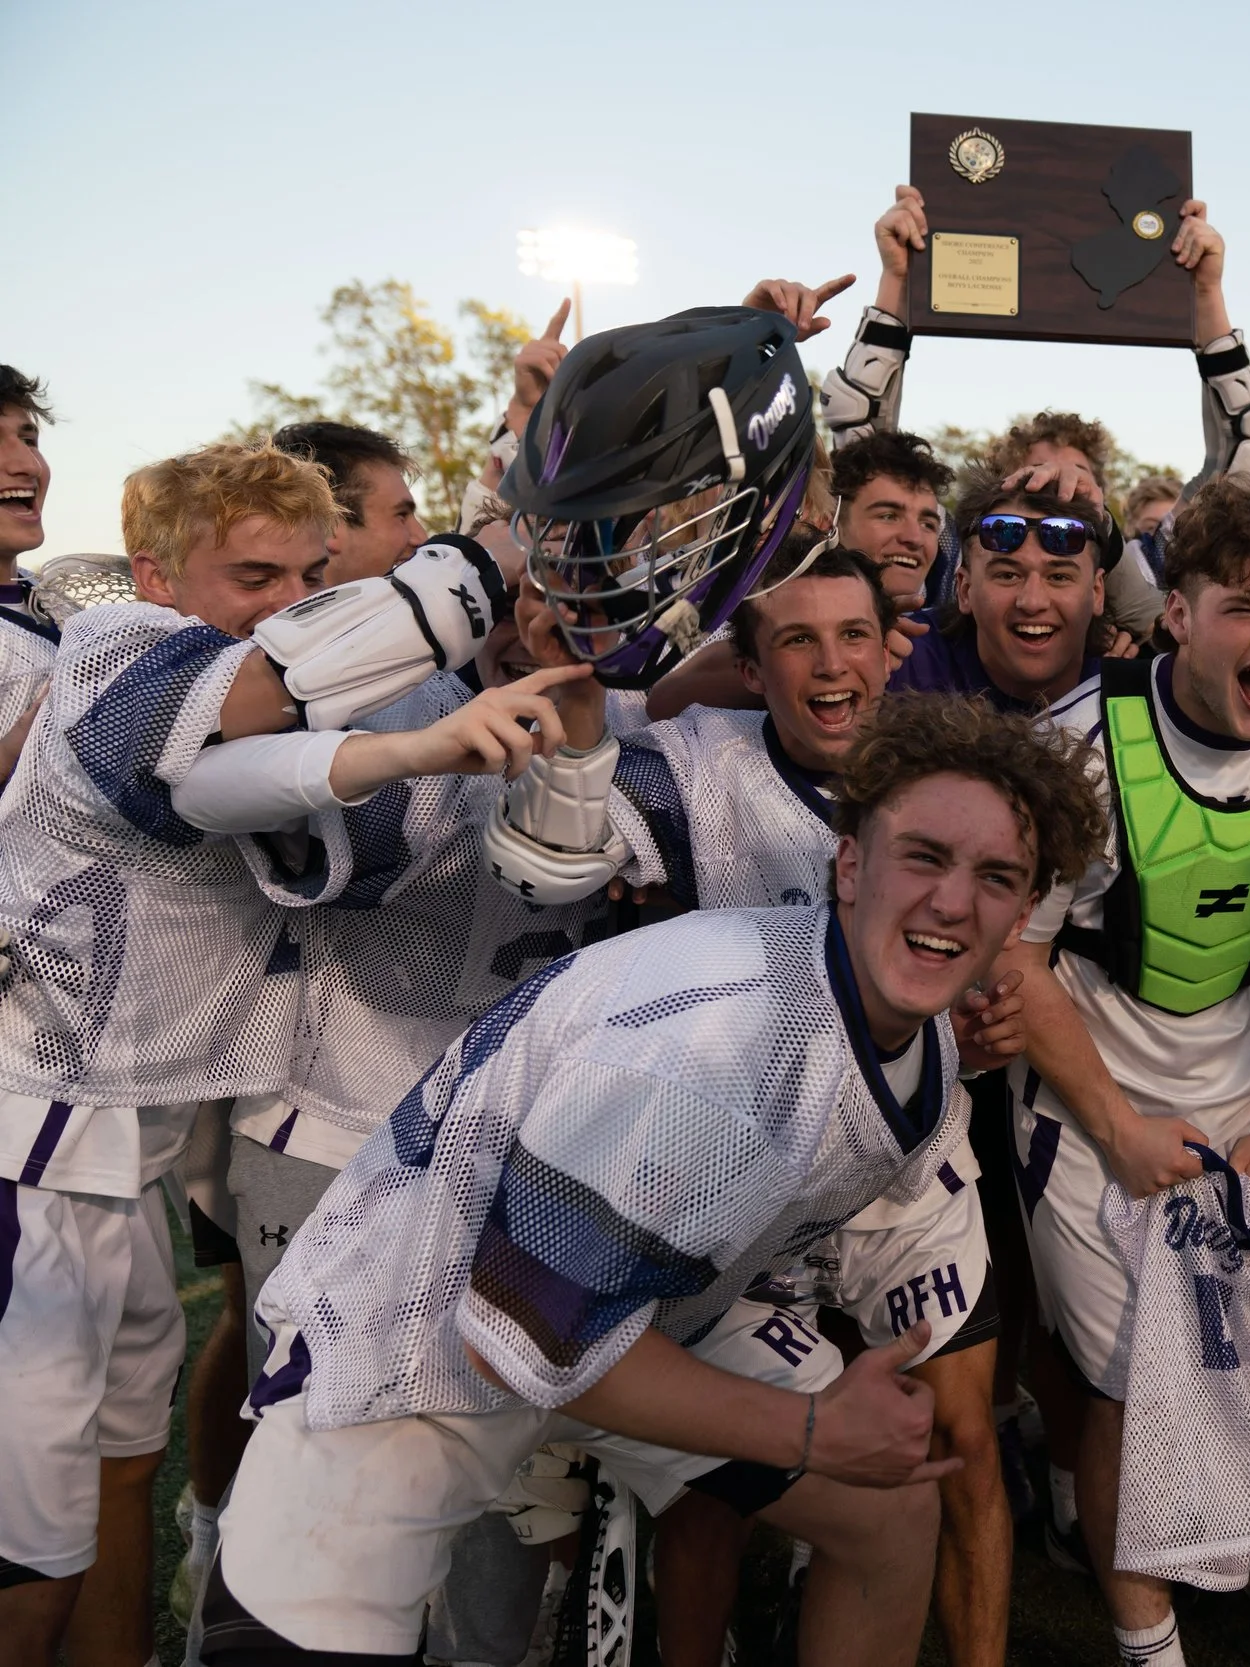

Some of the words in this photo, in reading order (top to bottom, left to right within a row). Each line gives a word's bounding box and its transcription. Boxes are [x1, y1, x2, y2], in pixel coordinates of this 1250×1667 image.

[448, 583, 486, 639] STX
[886, 1262, 968, 1338] RFH
[751, 1310, 820, 1368] RF
